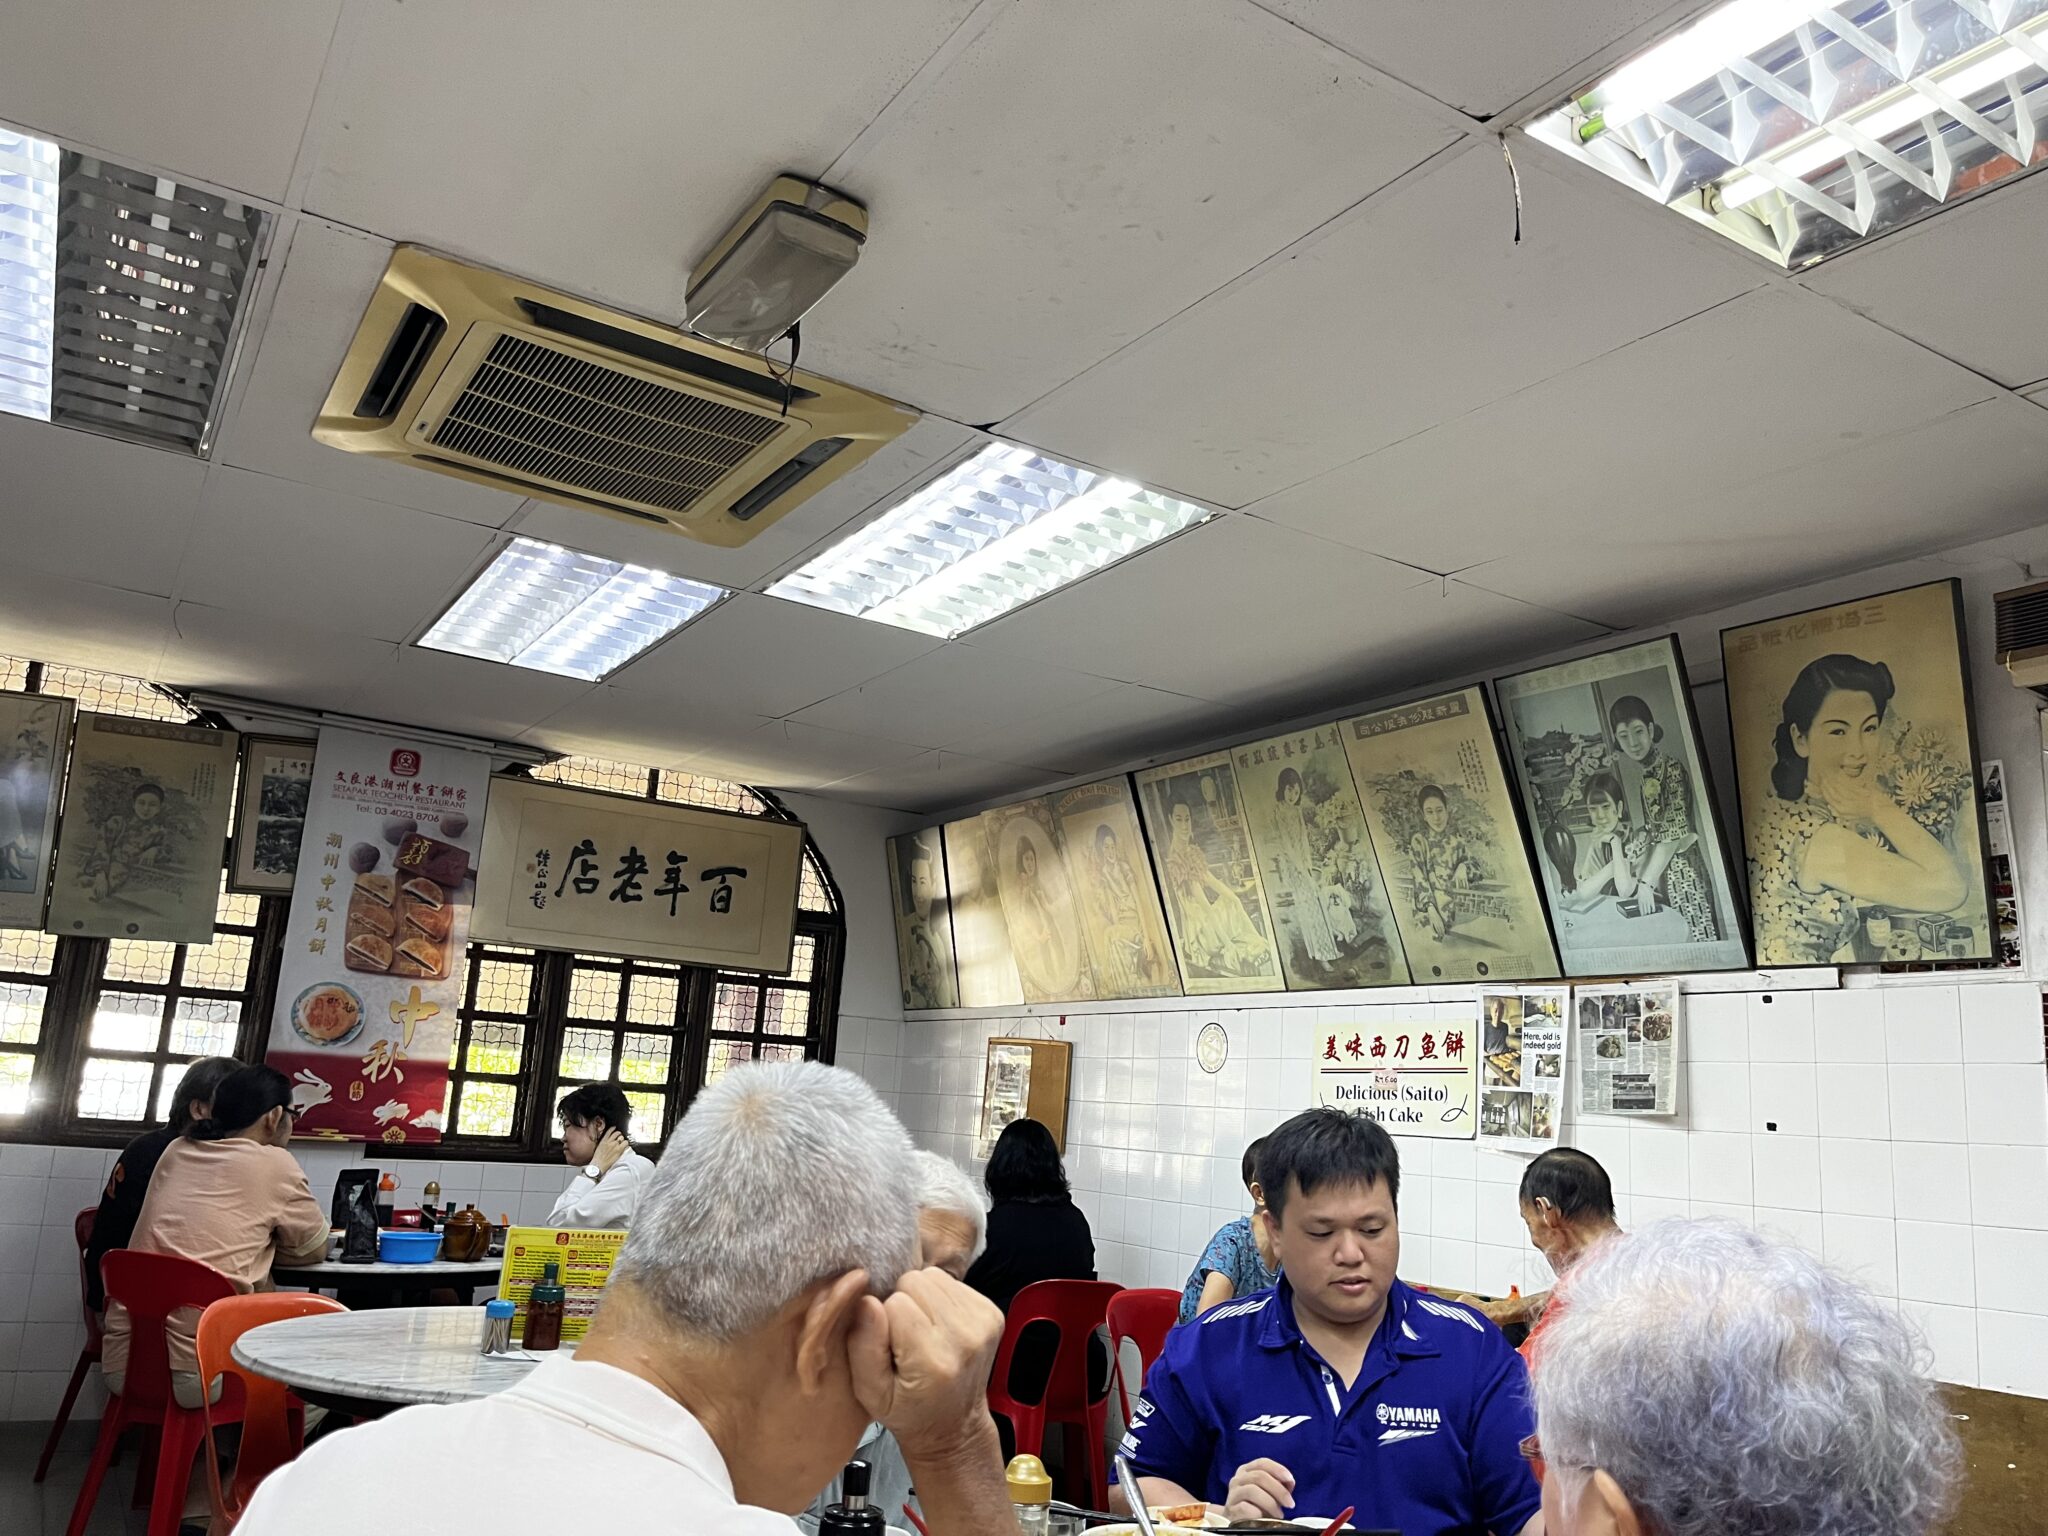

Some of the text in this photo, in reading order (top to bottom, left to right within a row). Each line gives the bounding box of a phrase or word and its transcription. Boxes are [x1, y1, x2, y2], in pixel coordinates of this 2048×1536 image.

[332, 784, 368, 797] SETAPAK
[371, 789, 413, 802] TEOCHEW
[415, 796, 466, 809] RESTAURANT
[356, 804, 372, 814] Tel:
[375, 807, 387, 816] 03
[389, 809, 414, 819] 4023
[416, 813, 440, 823] 8706
[554, 839, 747, 916] 百年老店
[1523, 1031, 1561, 1041] Here, old is
[1523, 1041, 1562, 1051] indeed gold
[1336, 1084, 1448, 1103] Delicious (Saito)
[1389, 1106, 1423, 1123] Cake
[1388, 1406, 1441, 1423] YAMAHA
[1380, 1420, 1438, 1429] RACING
